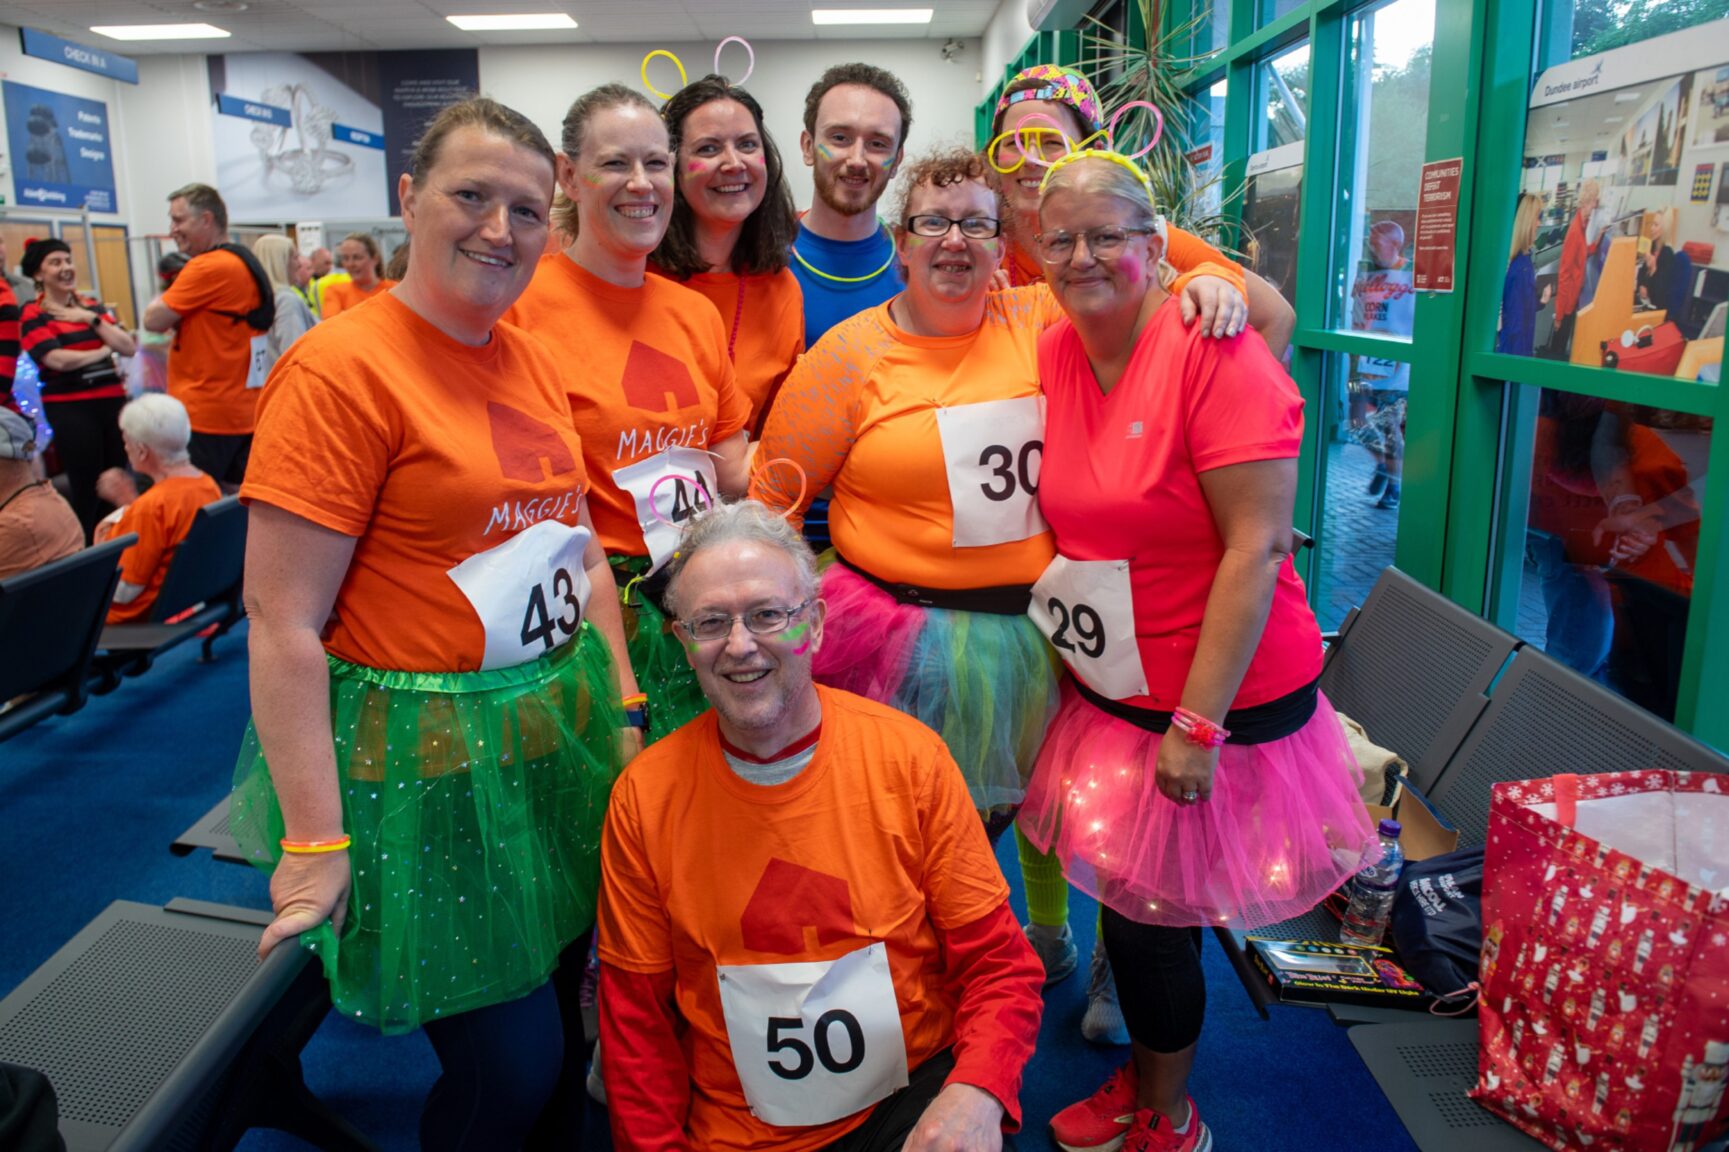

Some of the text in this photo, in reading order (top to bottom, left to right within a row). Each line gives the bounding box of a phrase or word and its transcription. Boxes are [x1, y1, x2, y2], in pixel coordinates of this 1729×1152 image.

[1544, 73, 1599, 97] Dundee airport
[1365, 302, 1389, 313] CORN
[617, 419, 709, 460] MAGGIE'S
[978, 440, 1045, 502] 30
[483, 485, 584, 536] MAGGIE'S
[520, 568, 580, 650] 43
[1047, 597, 1106, 659] 29
[767, 1009, 866, 1080] 50
